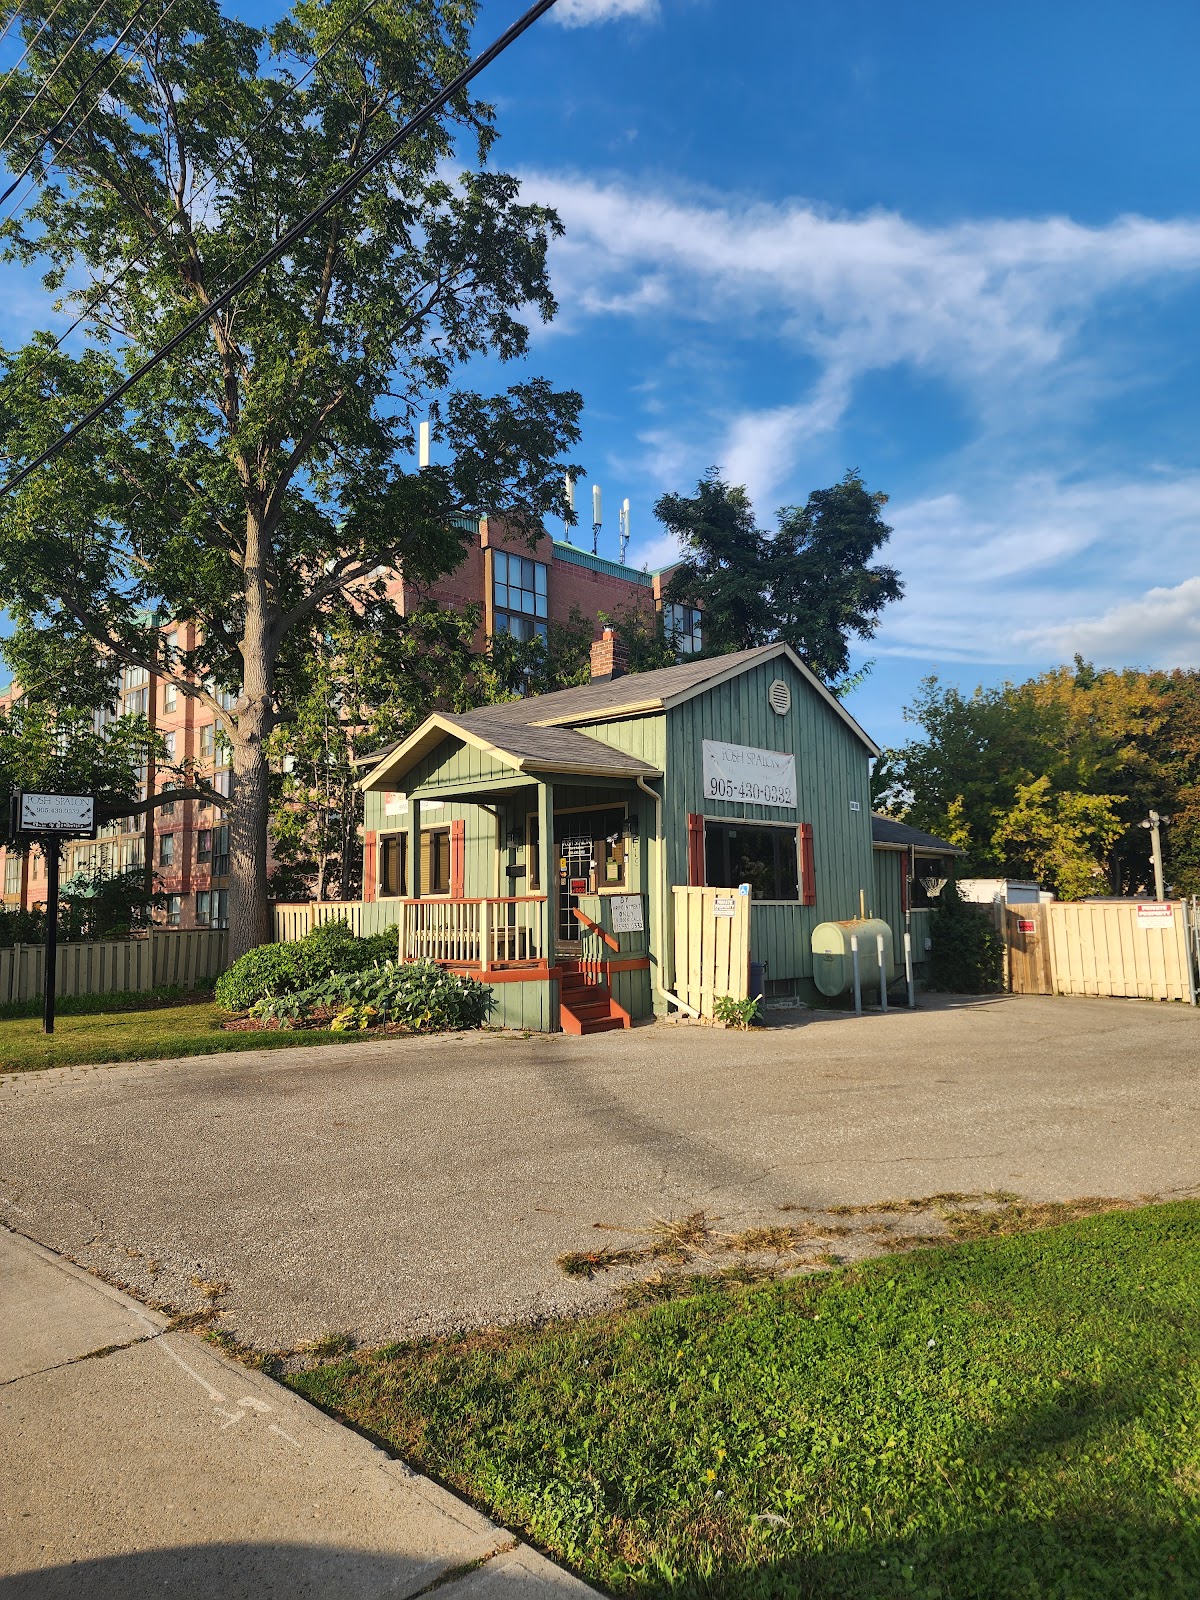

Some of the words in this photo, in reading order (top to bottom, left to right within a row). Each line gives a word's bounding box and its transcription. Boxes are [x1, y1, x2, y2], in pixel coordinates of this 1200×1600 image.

[721, 747, 744, 764] POSH
[710, 777, 792, 804] 905-430-0332
[27, 795, 52, 805] POSH
[55, 796, 90, 807] SPALON
[620, 896, 629, 904] BY
